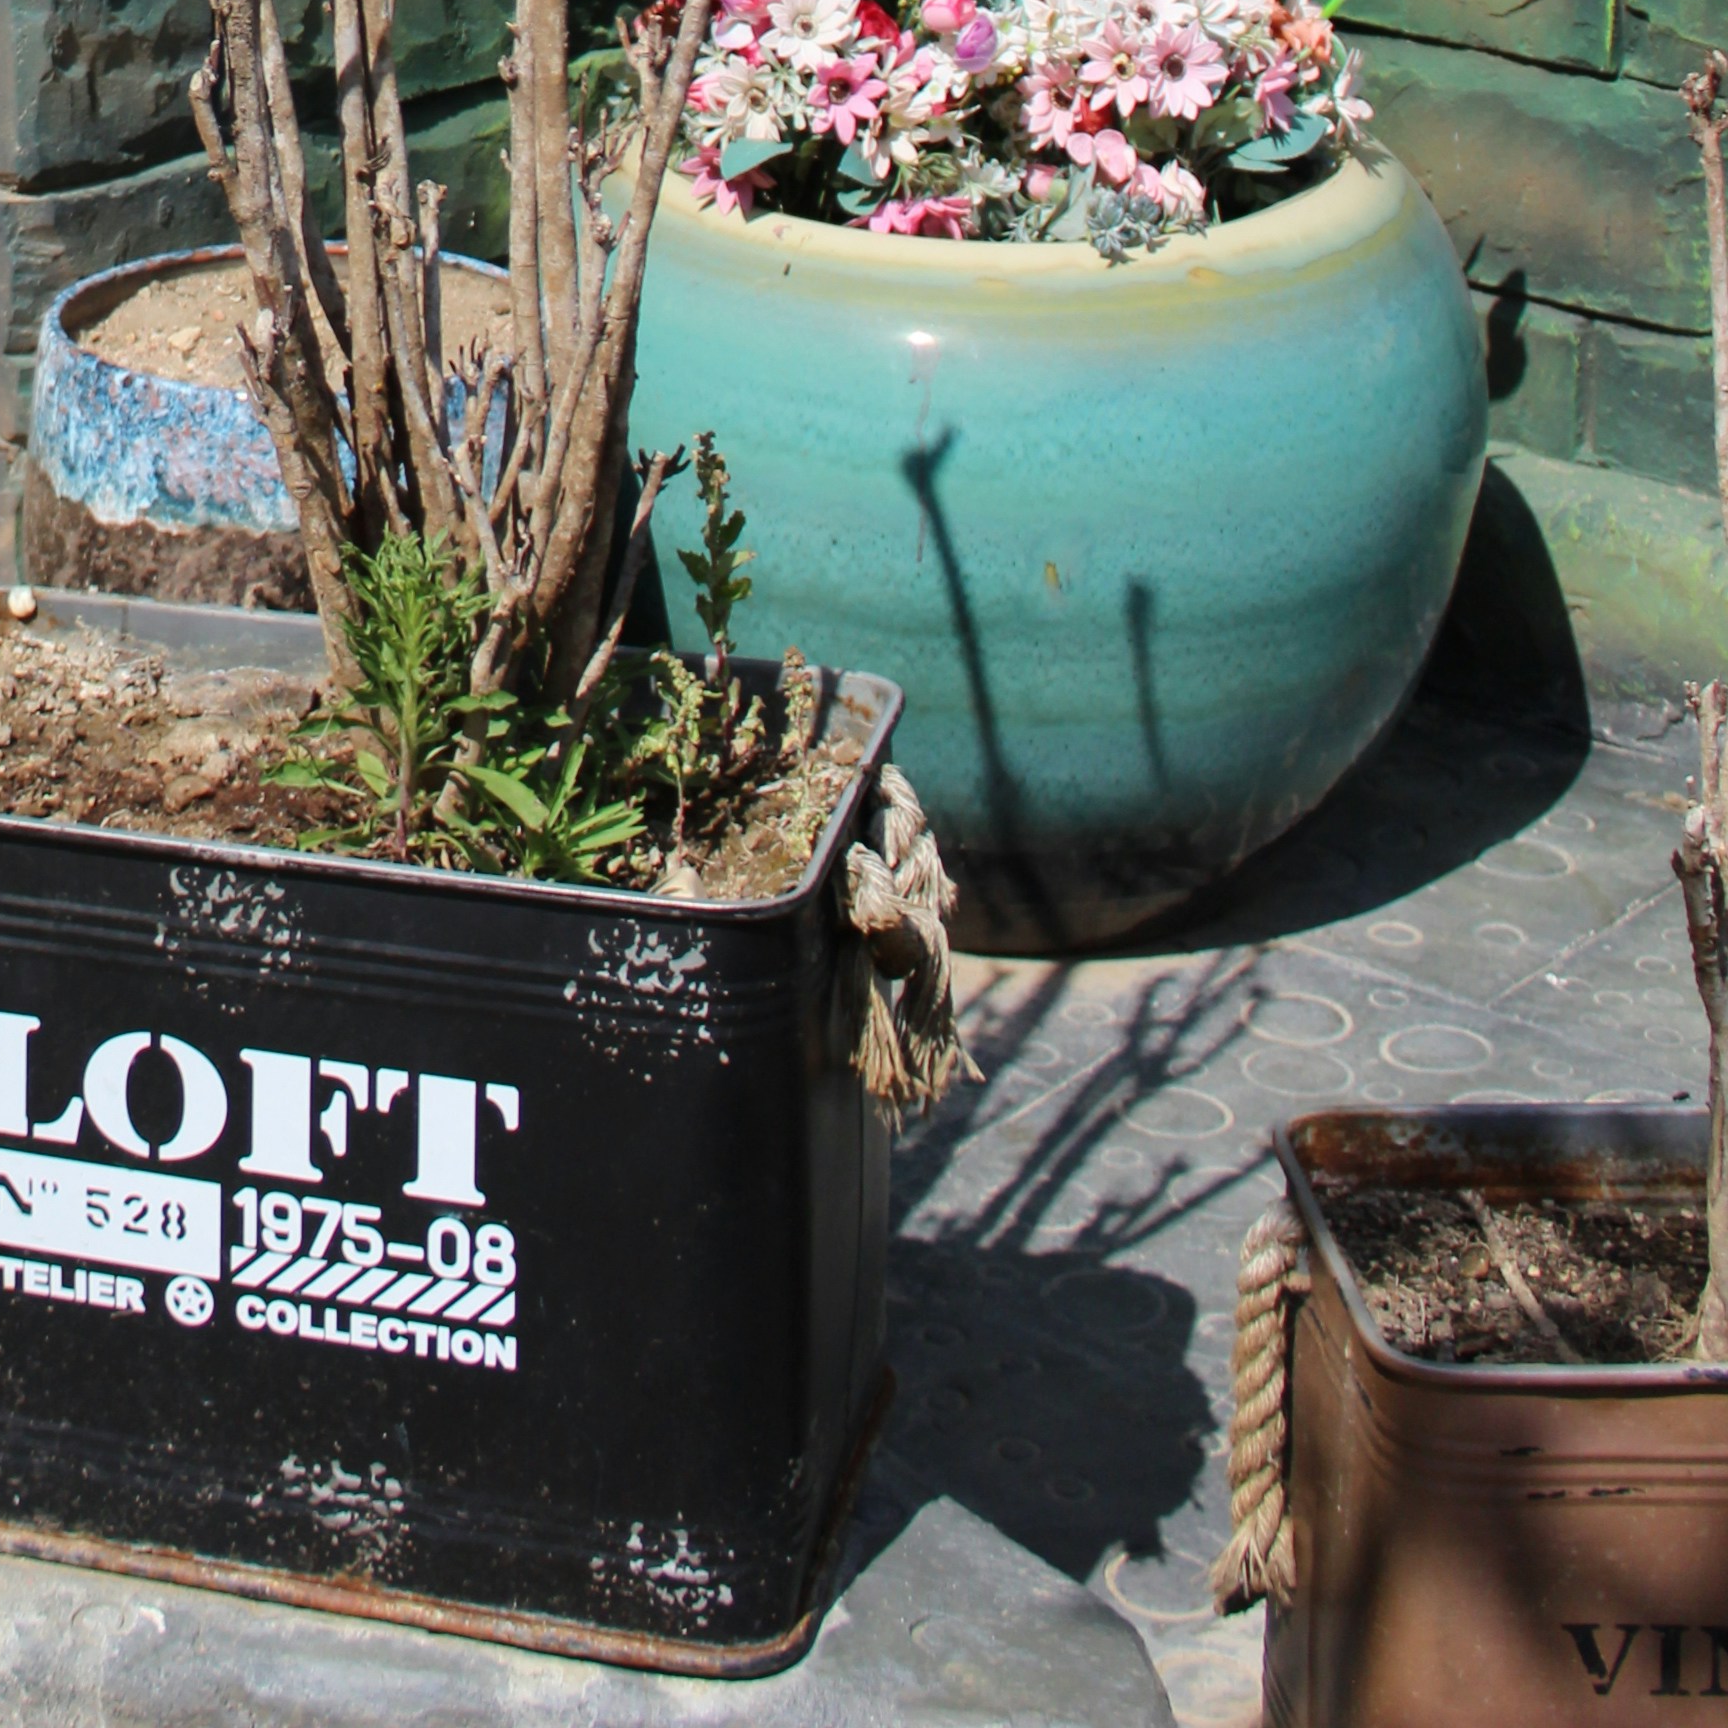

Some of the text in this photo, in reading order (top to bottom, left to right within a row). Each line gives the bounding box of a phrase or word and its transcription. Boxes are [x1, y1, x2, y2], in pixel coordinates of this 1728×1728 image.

[85, 1185, 187, 1241] 528
[232, 1186, 517, 1287] 1975-08
[235, 1294, 518, 1372] COLLECTION
